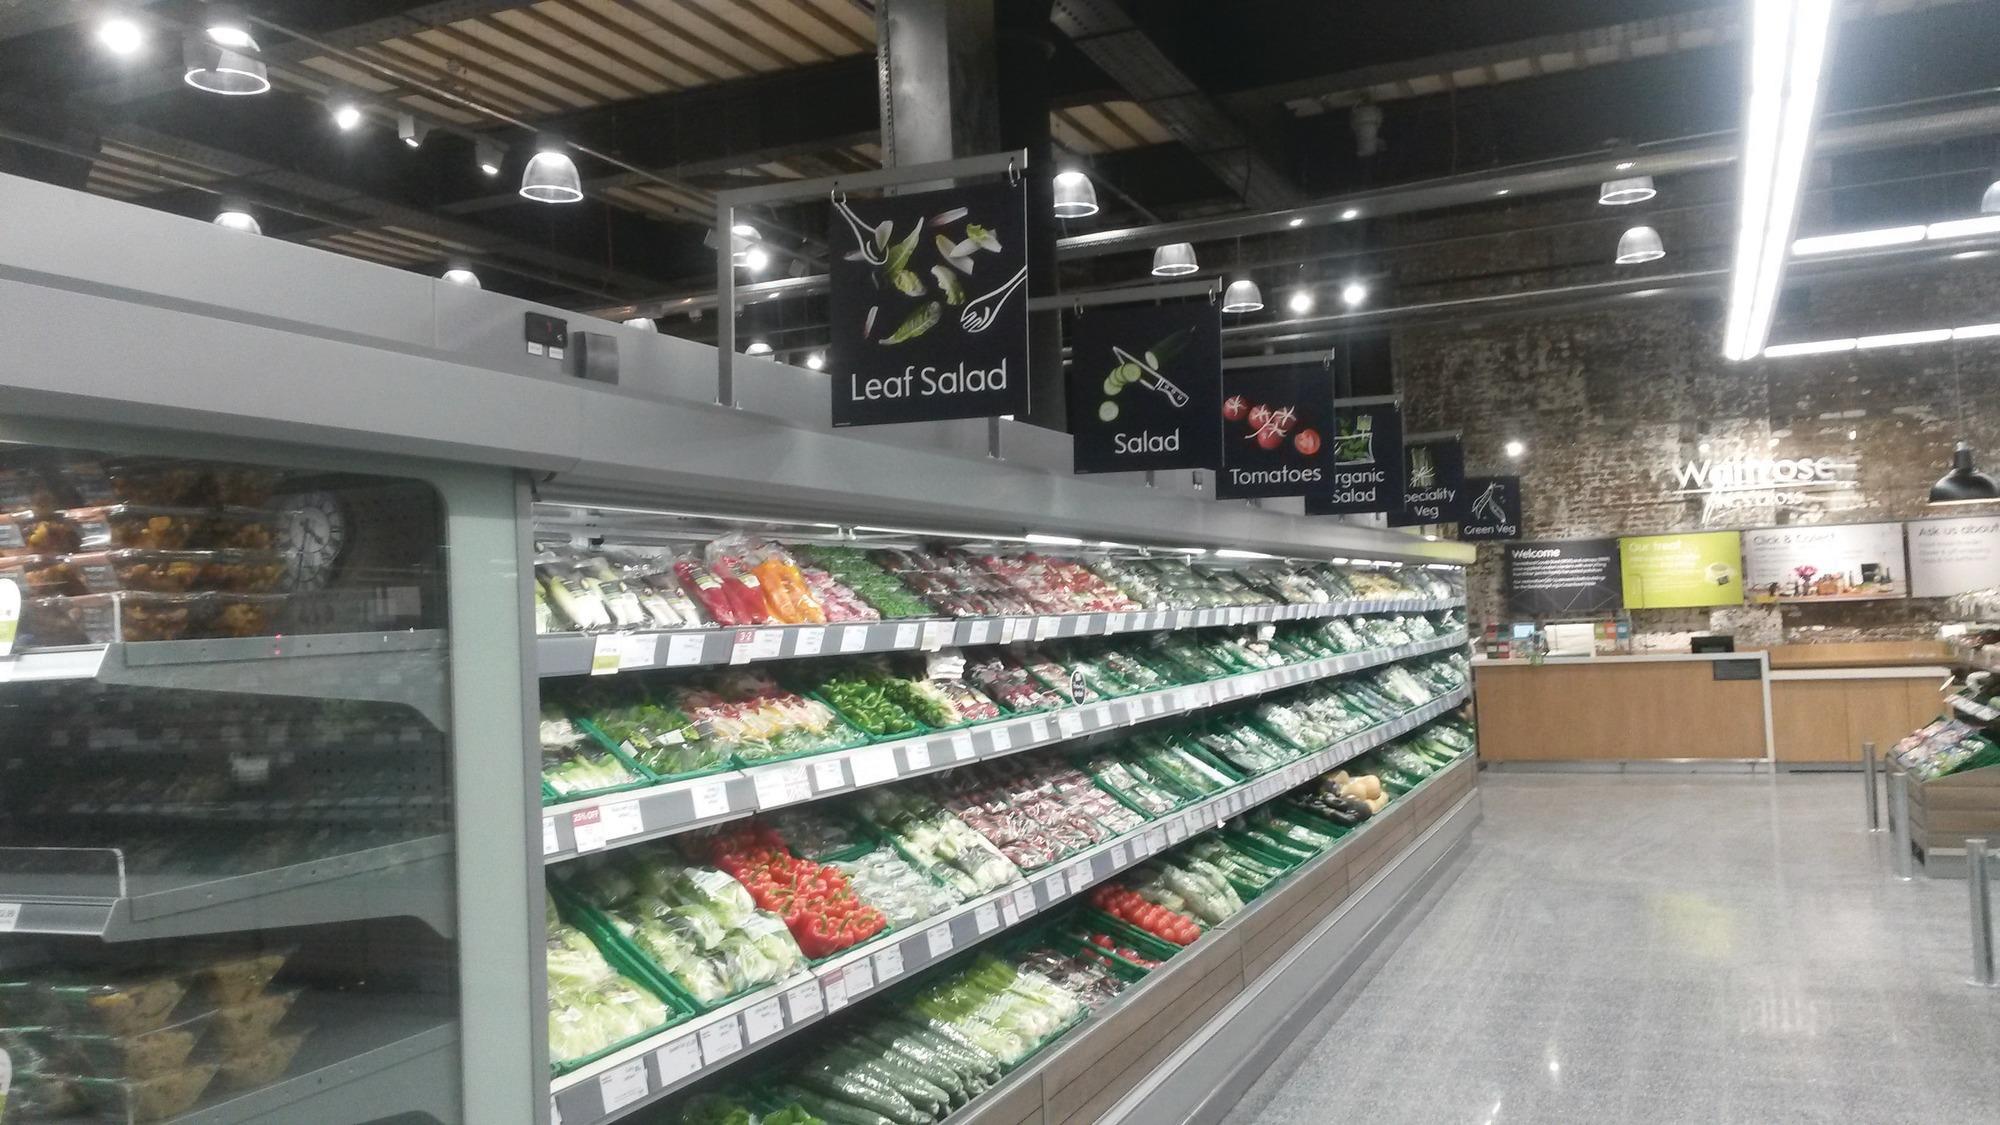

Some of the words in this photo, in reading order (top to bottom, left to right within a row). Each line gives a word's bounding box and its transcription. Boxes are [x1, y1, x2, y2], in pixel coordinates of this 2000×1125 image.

[851, 365, 915, 401] Leaf
[920, 357, 1008, 396] Salad
[1113, 427, 1181, 455] Salad
[1228, 464, 1322, 485] Tomatoes
[1334, 467, 1385, 489] rganic
[1332, 486, 1376, 504] Salad
[1403, 487, 1456, 503] peciality
[1413, 505, 1440, 520] Veg
[1463, 525, 1494, 535] Green
[1496, 523, 1516, 536] Veg
[1512, 548, 1561, 559] Welcome
